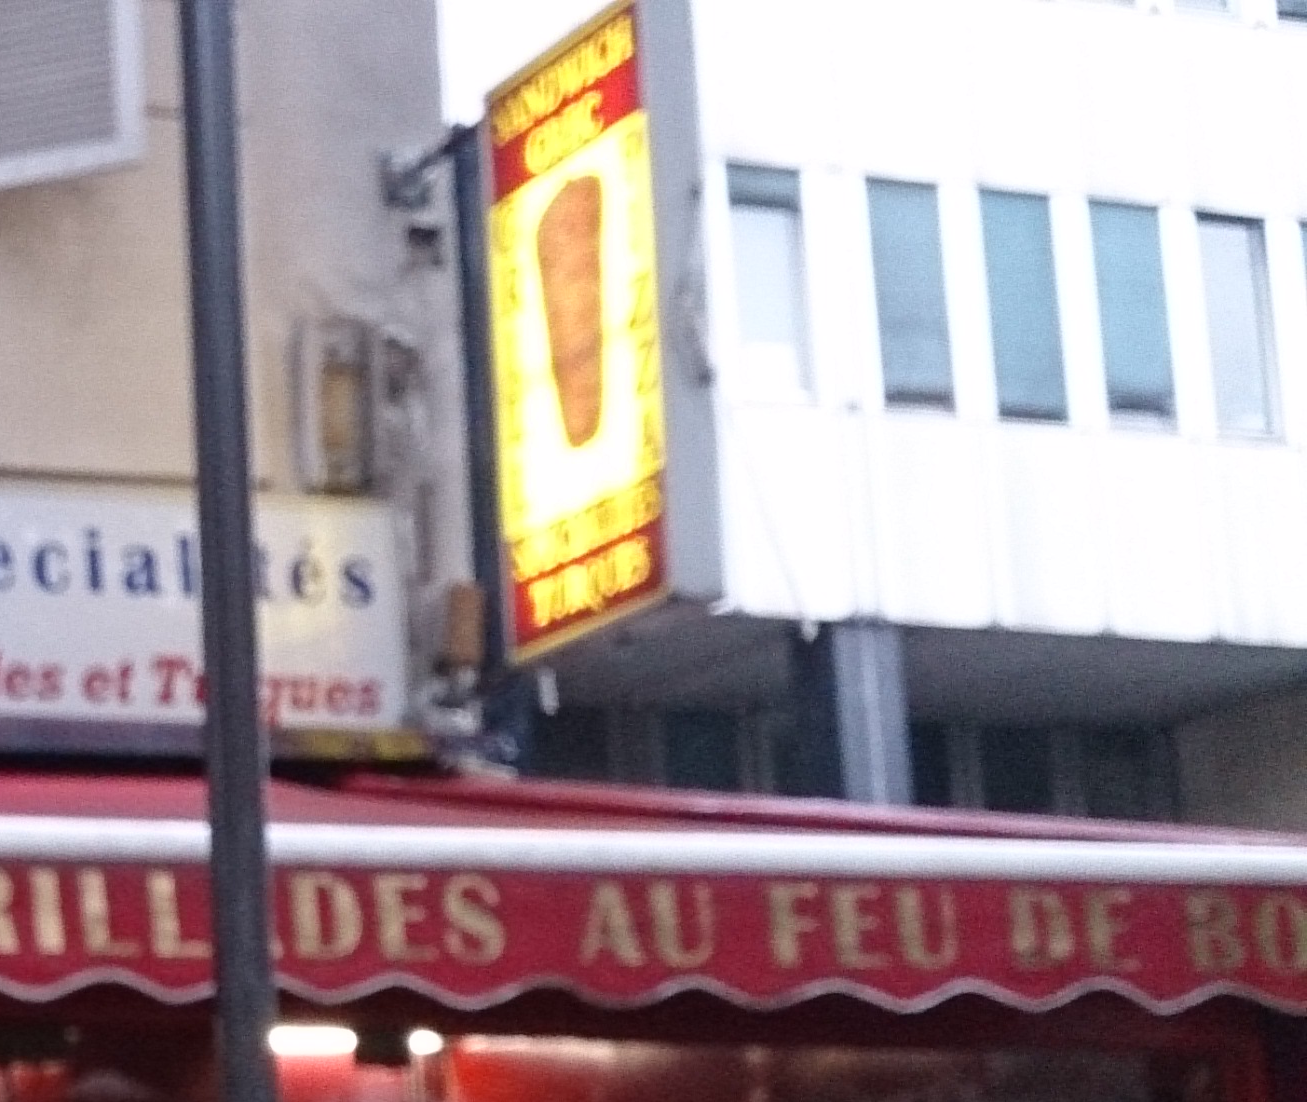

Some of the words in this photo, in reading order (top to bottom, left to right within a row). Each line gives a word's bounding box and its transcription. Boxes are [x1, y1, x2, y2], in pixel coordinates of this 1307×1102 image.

[82, 658, 134, 703] et
[154, 653, 382, 728] Tques
[581, 880, 714, 968] AU
[767, 880, 959, 970] FEU
[1009, 886, 1140, 973] DE
